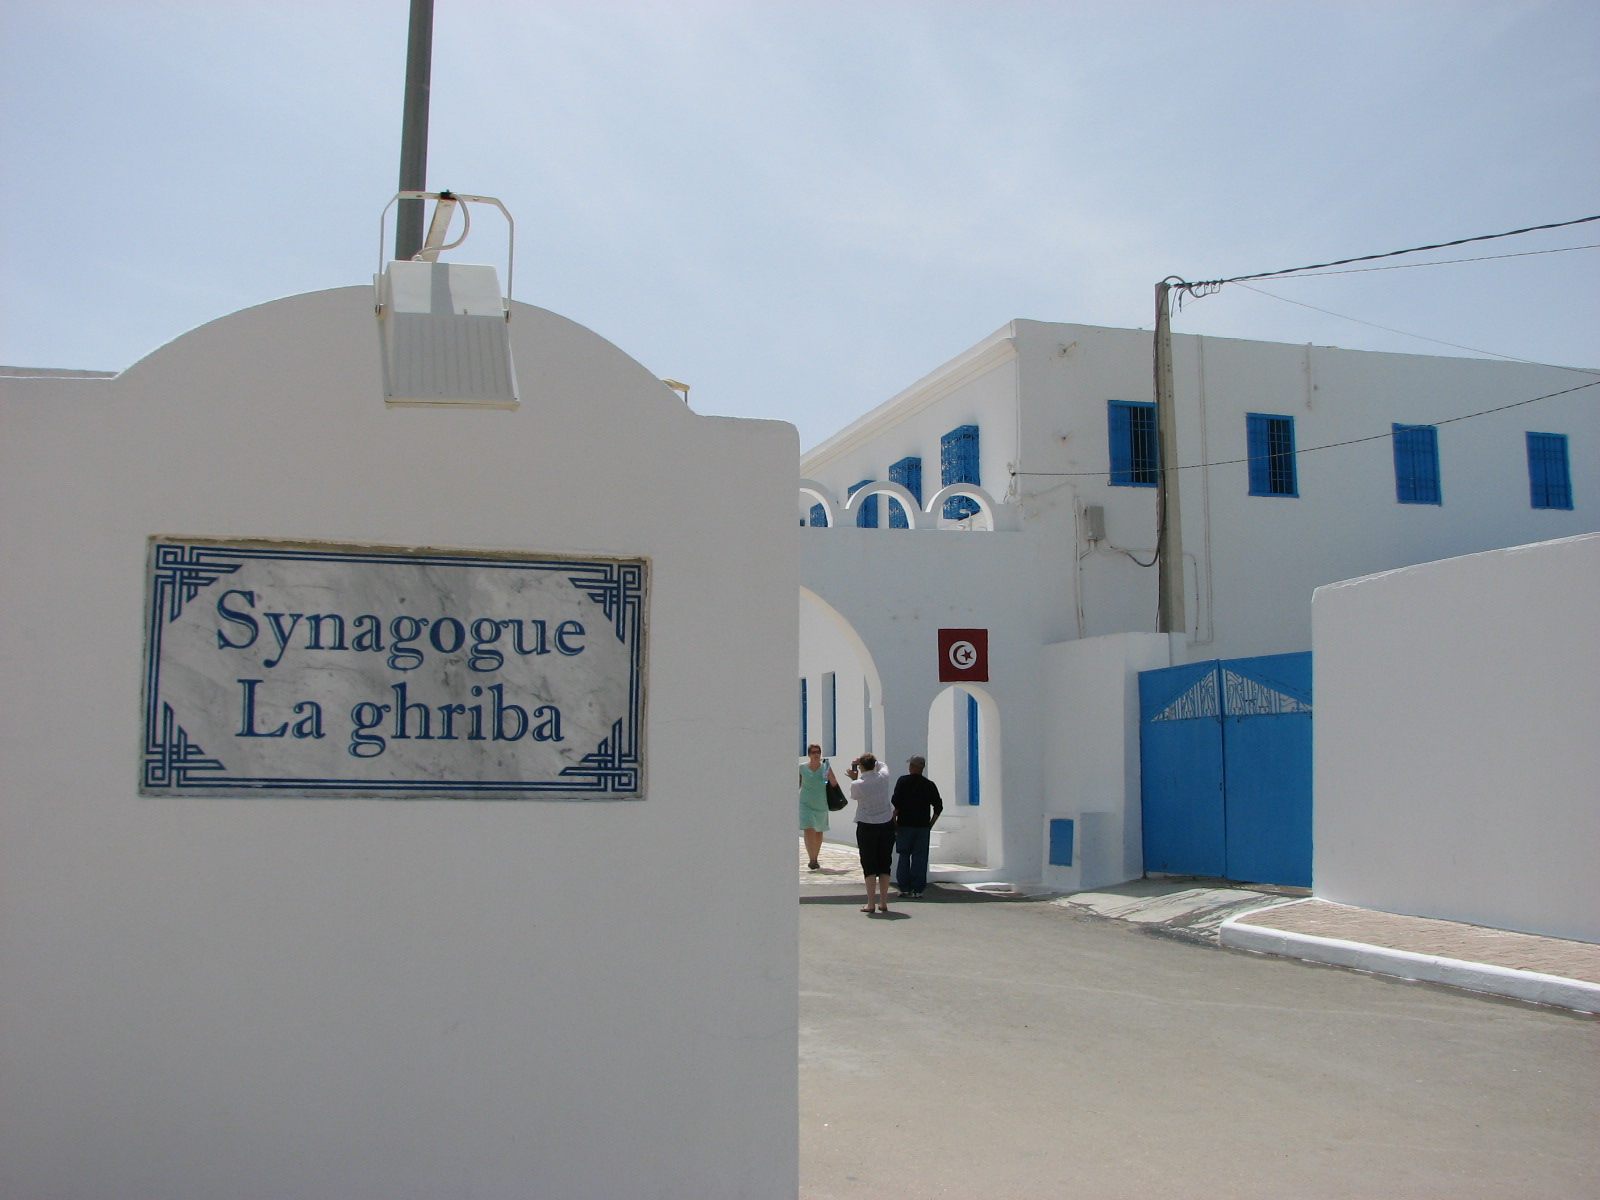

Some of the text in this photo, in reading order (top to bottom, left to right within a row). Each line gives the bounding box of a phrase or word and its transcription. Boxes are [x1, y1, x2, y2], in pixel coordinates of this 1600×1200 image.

[216, 588, 586, 673] Synagogue
[234, 679, 566, 759] La ghriba
